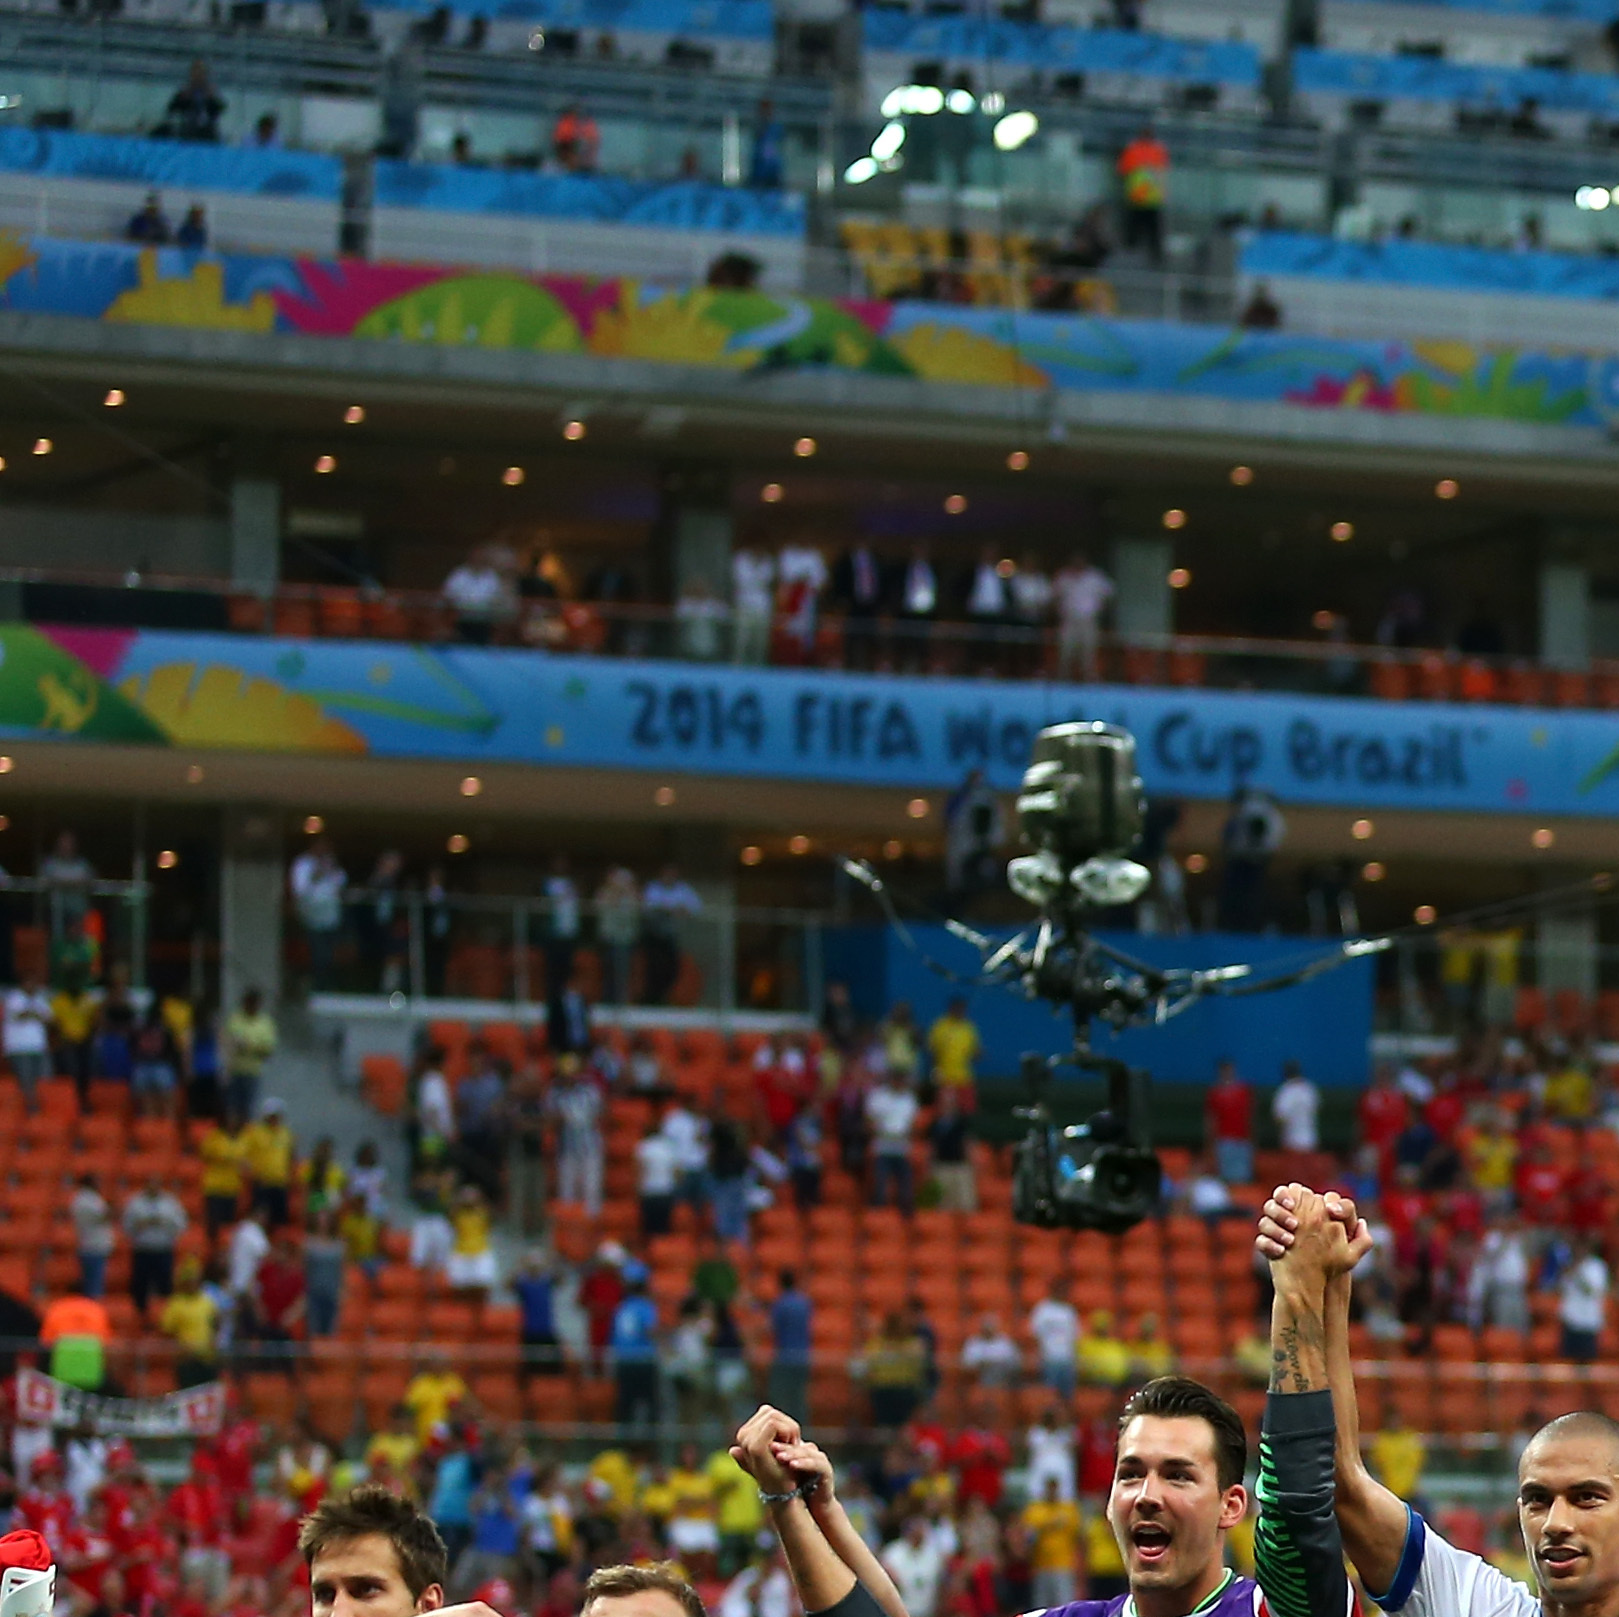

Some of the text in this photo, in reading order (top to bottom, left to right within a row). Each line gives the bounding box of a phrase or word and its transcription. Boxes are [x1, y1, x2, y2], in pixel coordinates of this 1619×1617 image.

[625, 680, 765, 754] 2014
[793, 690, 924, 760] FIFA
[1153, 709, 1262, 786] Cup
[1286, 714, 1468, 788] Brazil
